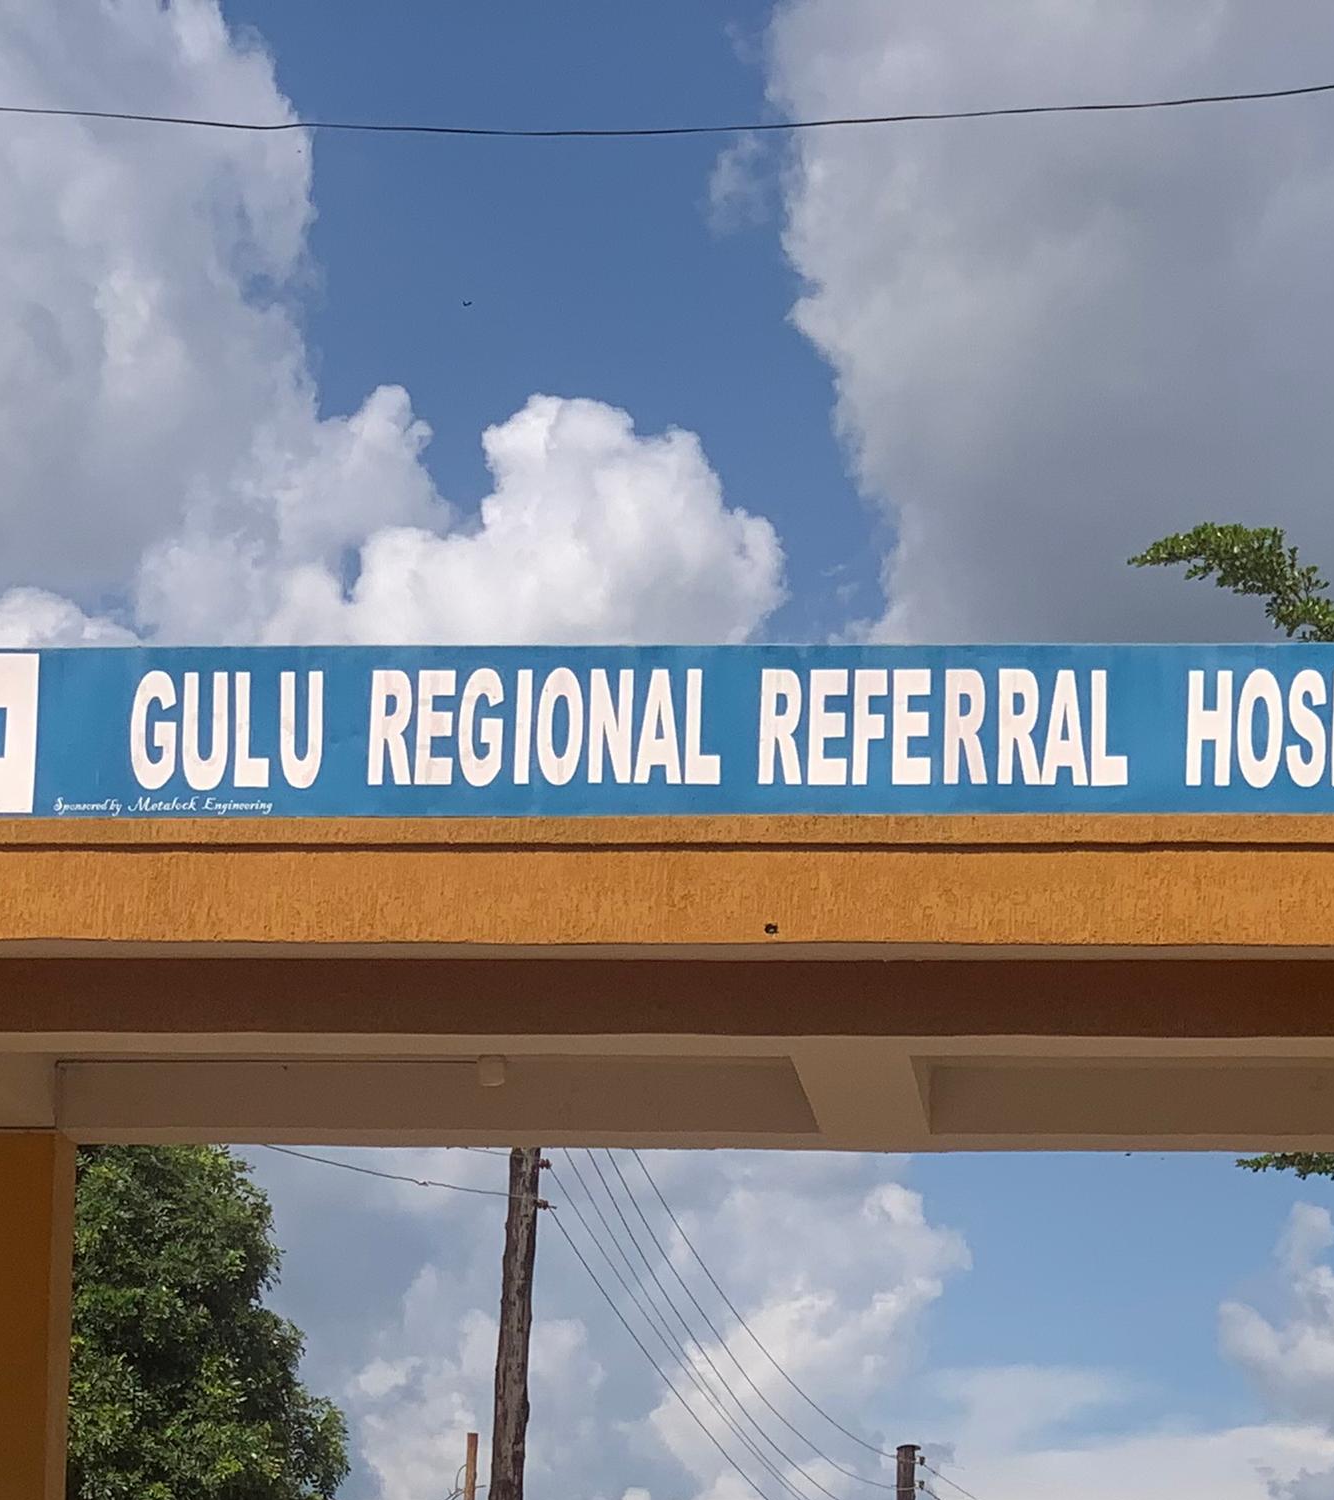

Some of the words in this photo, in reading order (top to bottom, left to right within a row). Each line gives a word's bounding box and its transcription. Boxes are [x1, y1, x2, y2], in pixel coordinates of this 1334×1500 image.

[131, 671, 324, 790] GULU
[368, 668, 720, 786] REGIONAL
[758, 669, 1127, 786] REFERRAL
[108, 799, 123, 817] by
[128, 796, 200, 811] Metalock
[202, 797, 273, 815] Engineering
